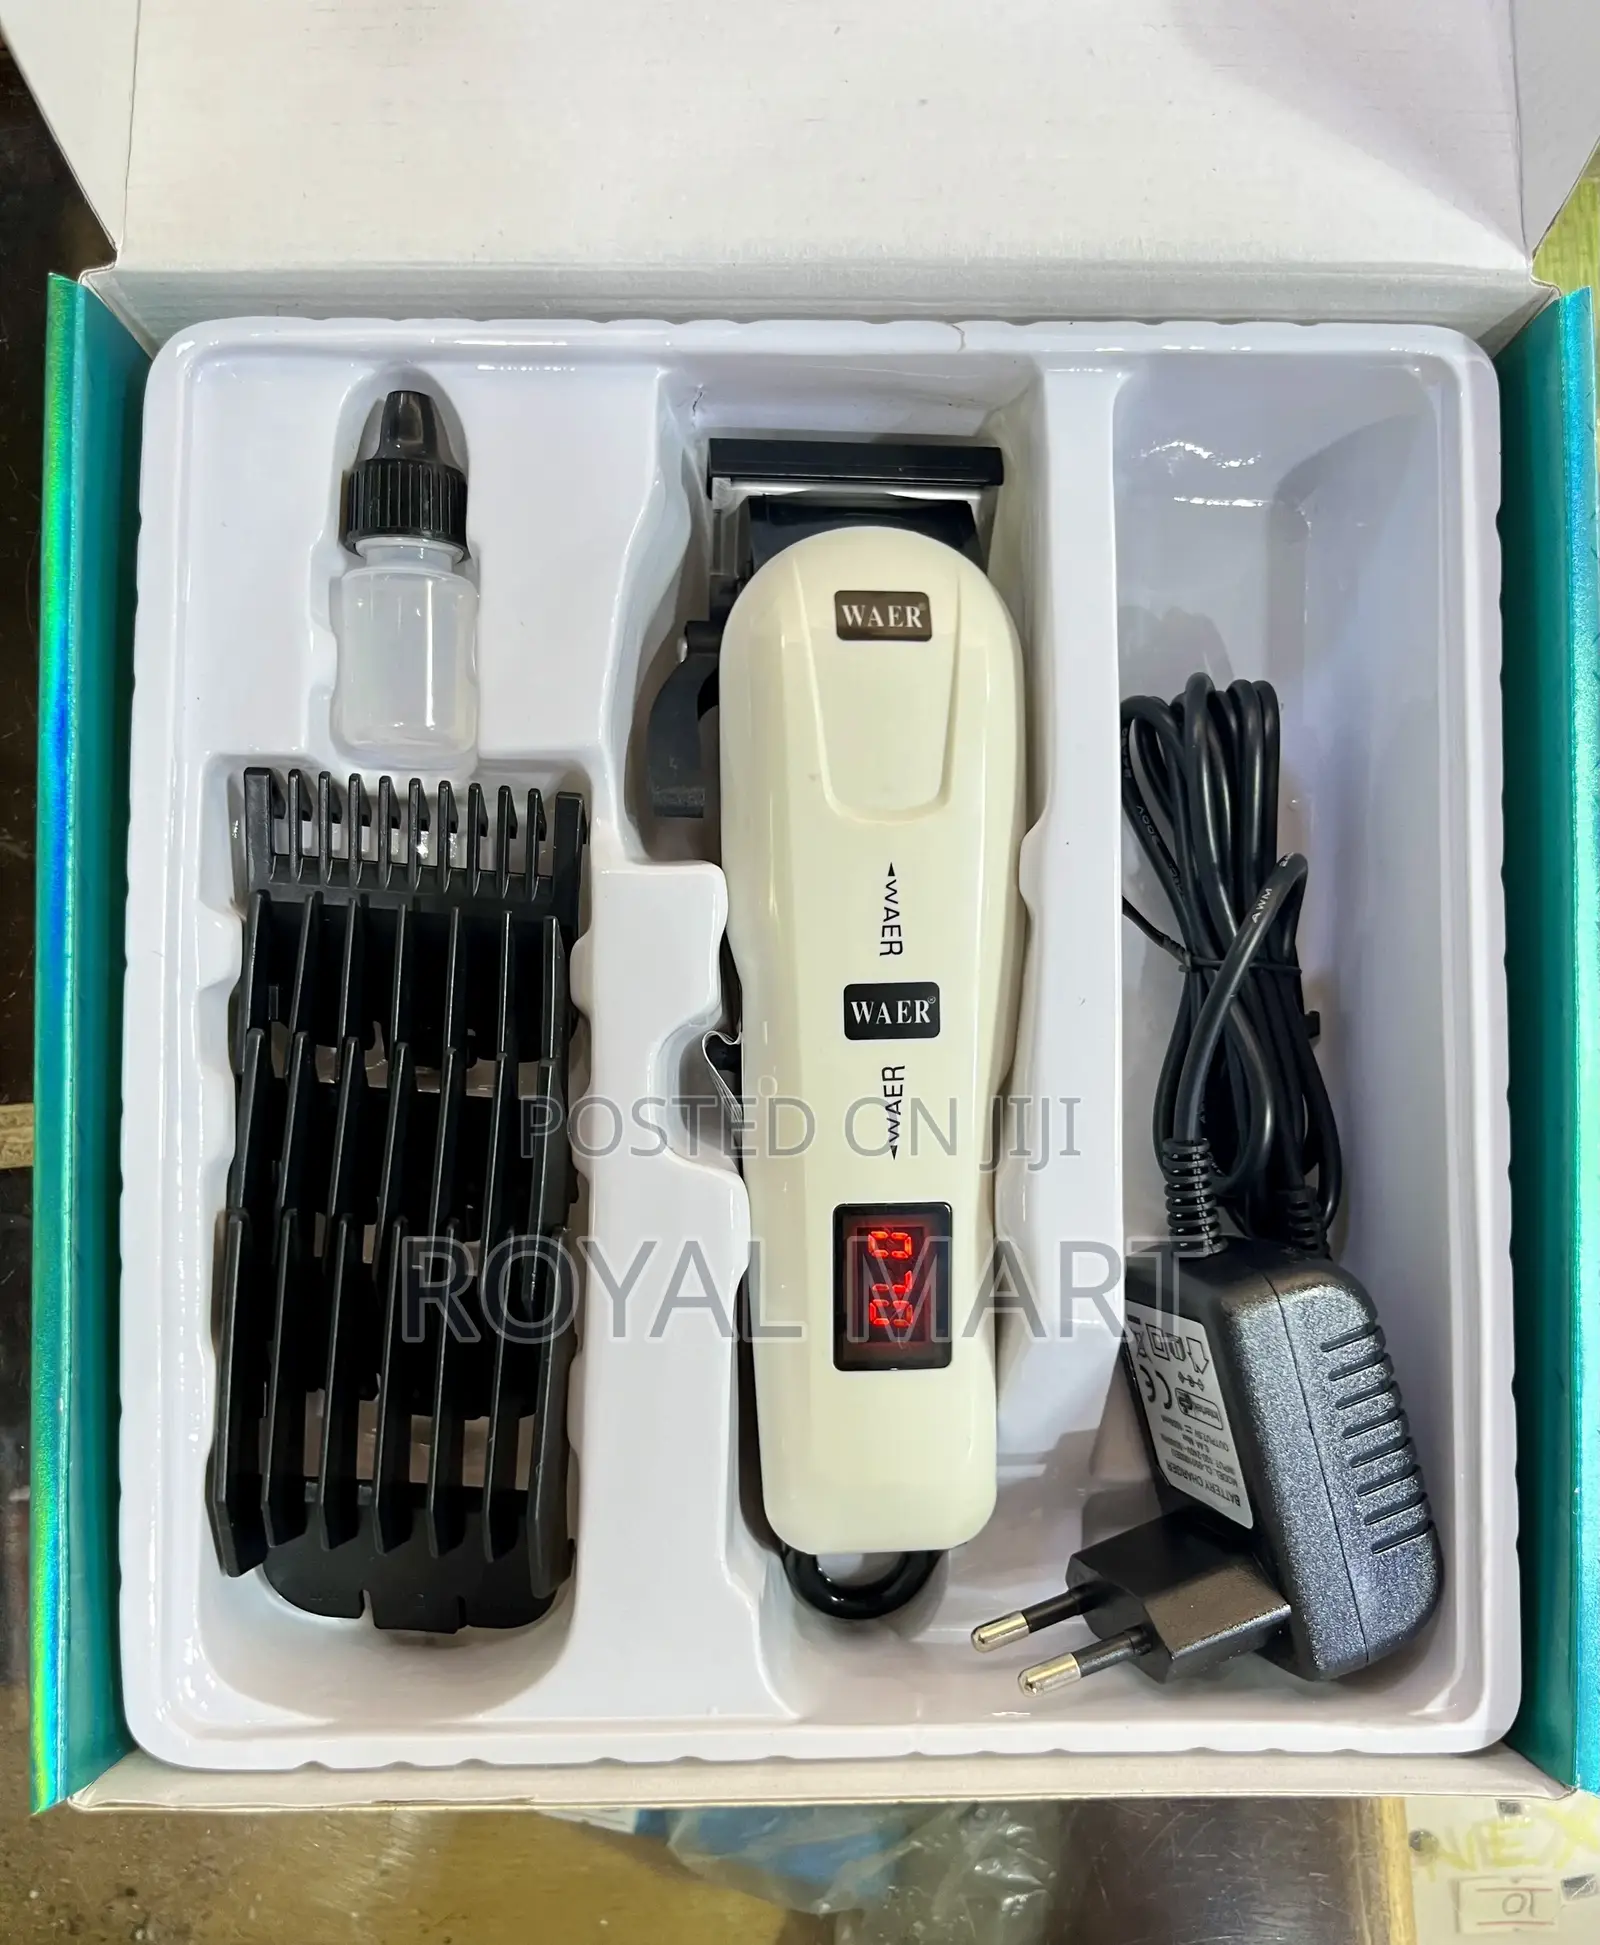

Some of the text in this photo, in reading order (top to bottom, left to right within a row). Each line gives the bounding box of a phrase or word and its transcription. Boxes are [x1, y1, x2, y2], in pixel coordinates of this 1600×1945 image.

[841, 604, 923, 629] WAER
[879, 879, 904, 957] WAER
[1251, 888, 1273, 924] AWM
[850, 999, 932, 1025] WAER
[881, 1065, 906, 1146] WAER
[1166, 1459, 1203, 1487] CHARGER
[1204, 1480, 1241, 1507] BATTERY
